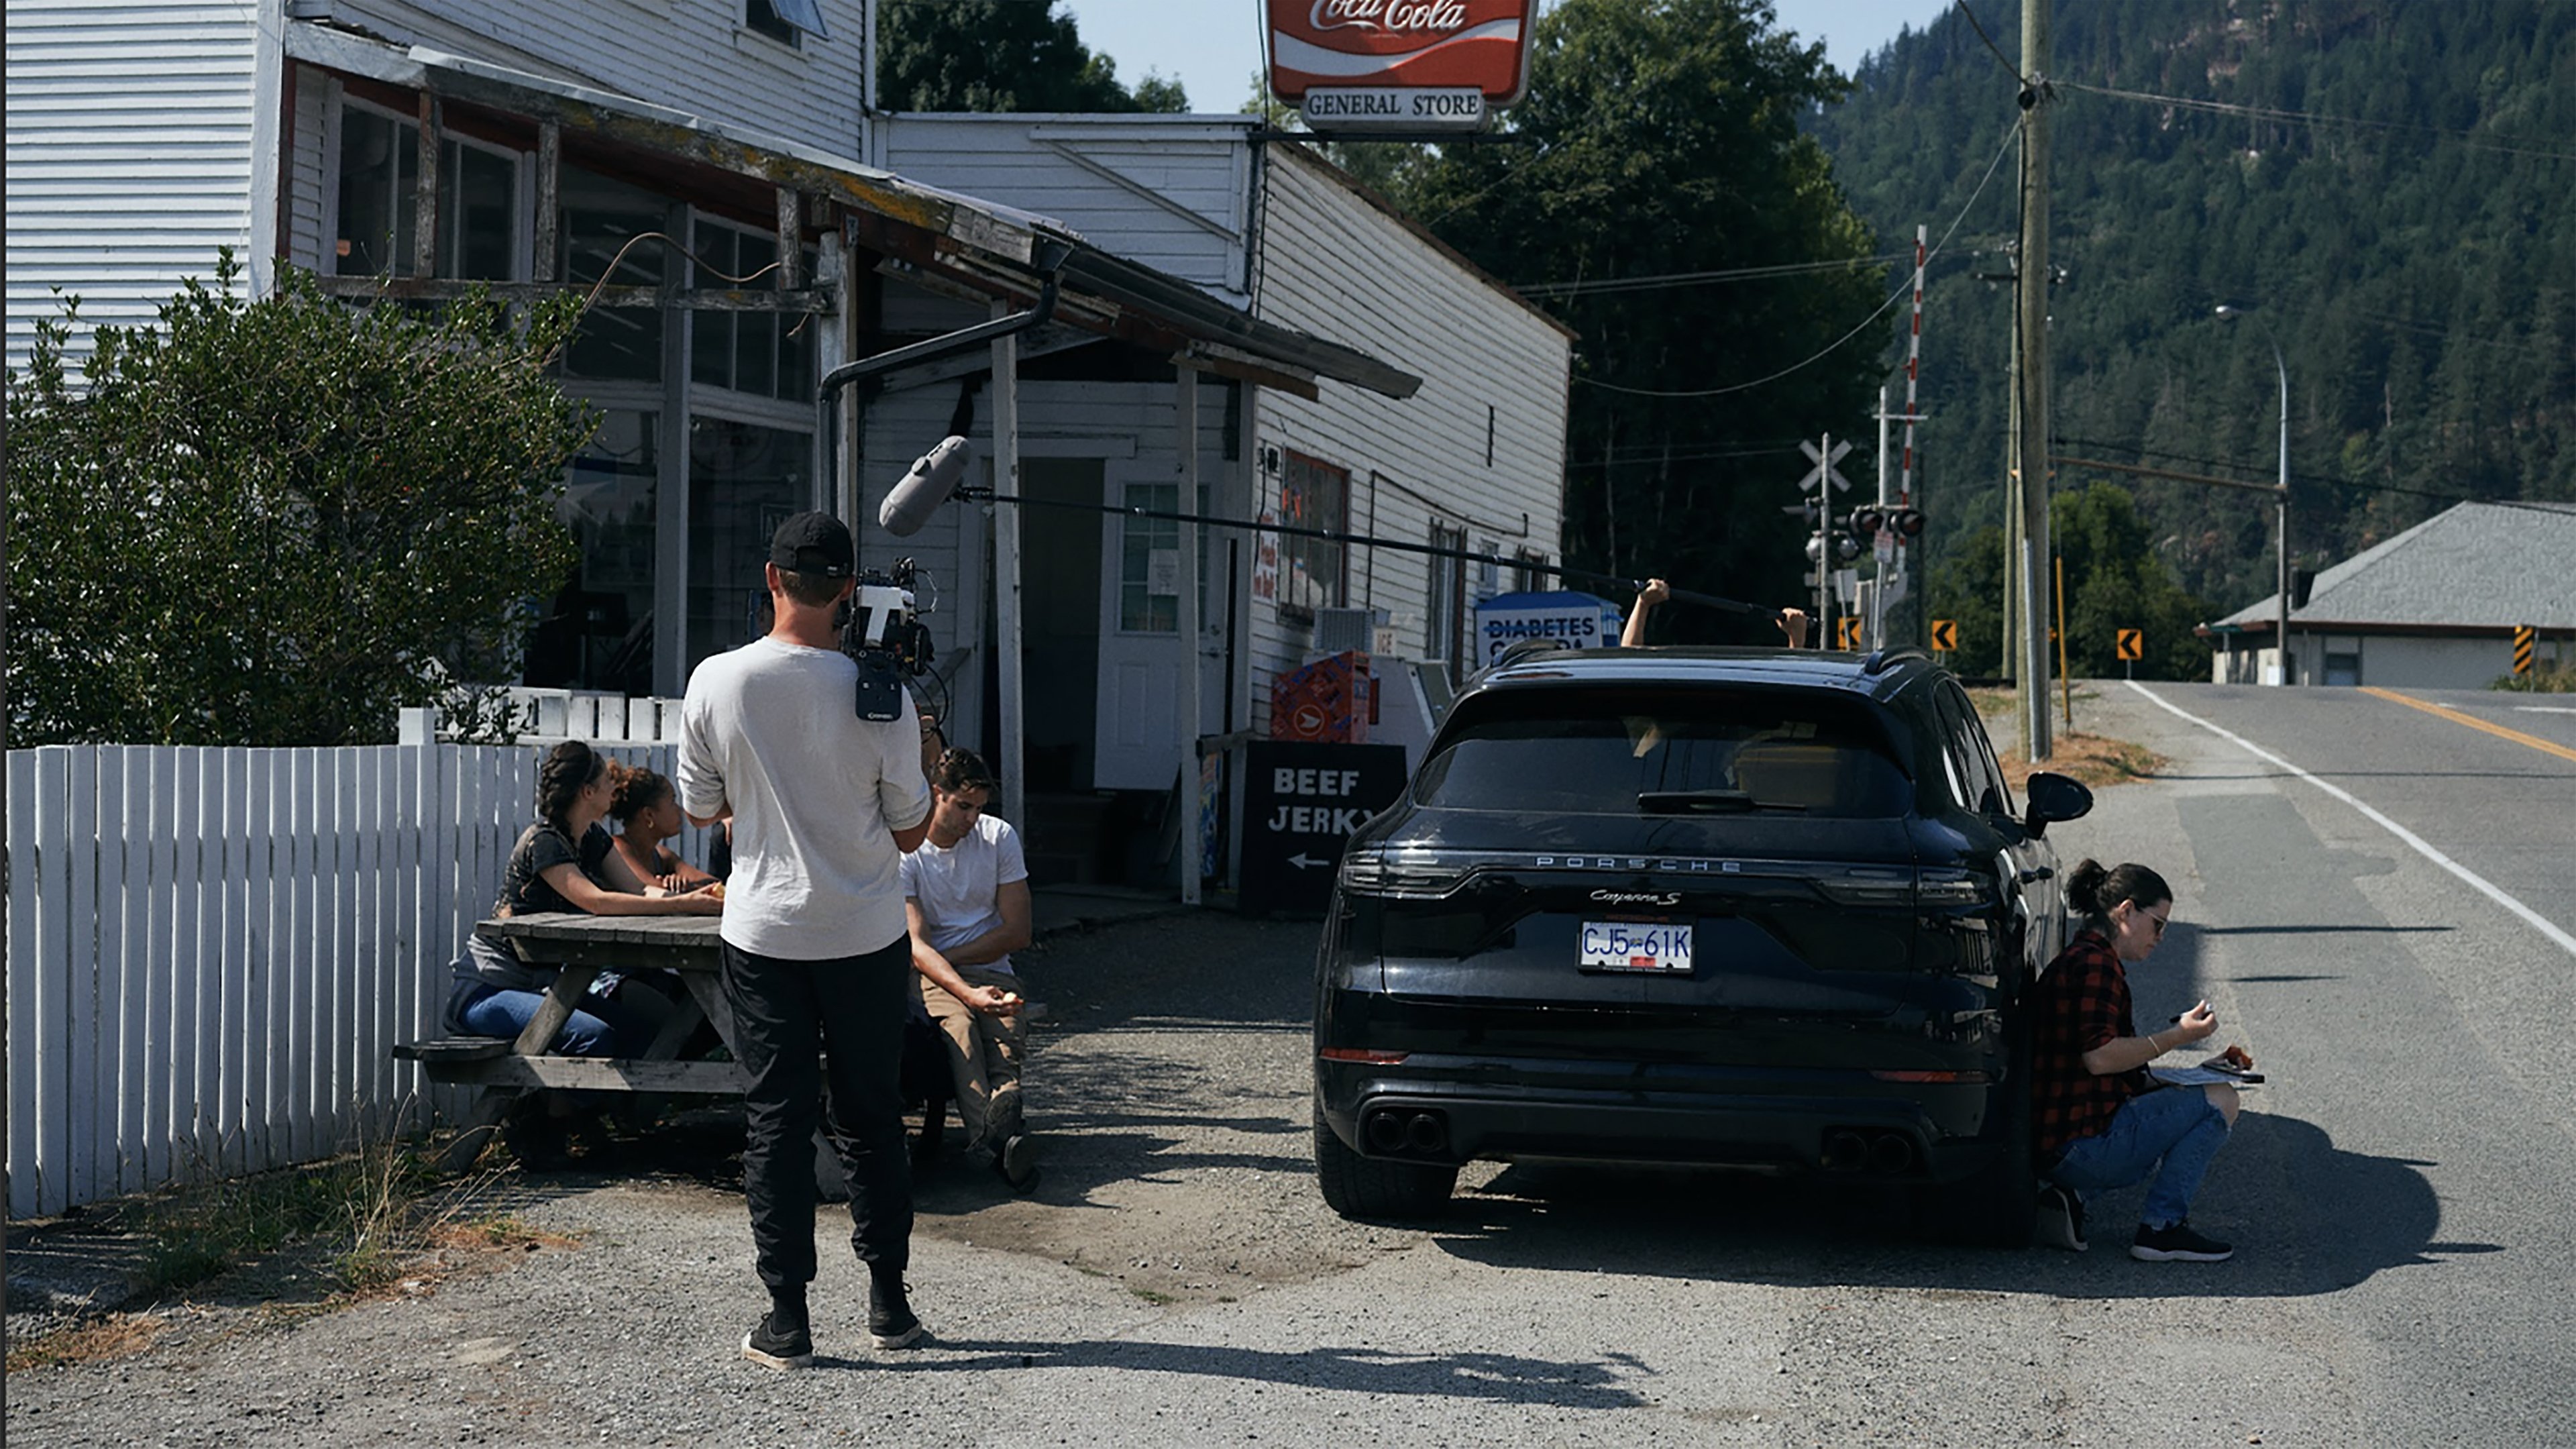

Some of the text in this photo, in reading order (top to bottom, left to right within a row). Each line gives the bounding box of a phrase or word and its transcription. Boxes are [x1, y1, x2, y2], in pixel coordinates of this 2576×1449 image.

[1308, 95, 1479, 115] GENERAL STORE
[1489, 617, 1595, 638] DIABETES
[1273, 767, 1360, 797] BEEF
[1536, 857, 1741, 873] PORSCHE
[1589, 888, 1682, 906] Cayenne S
